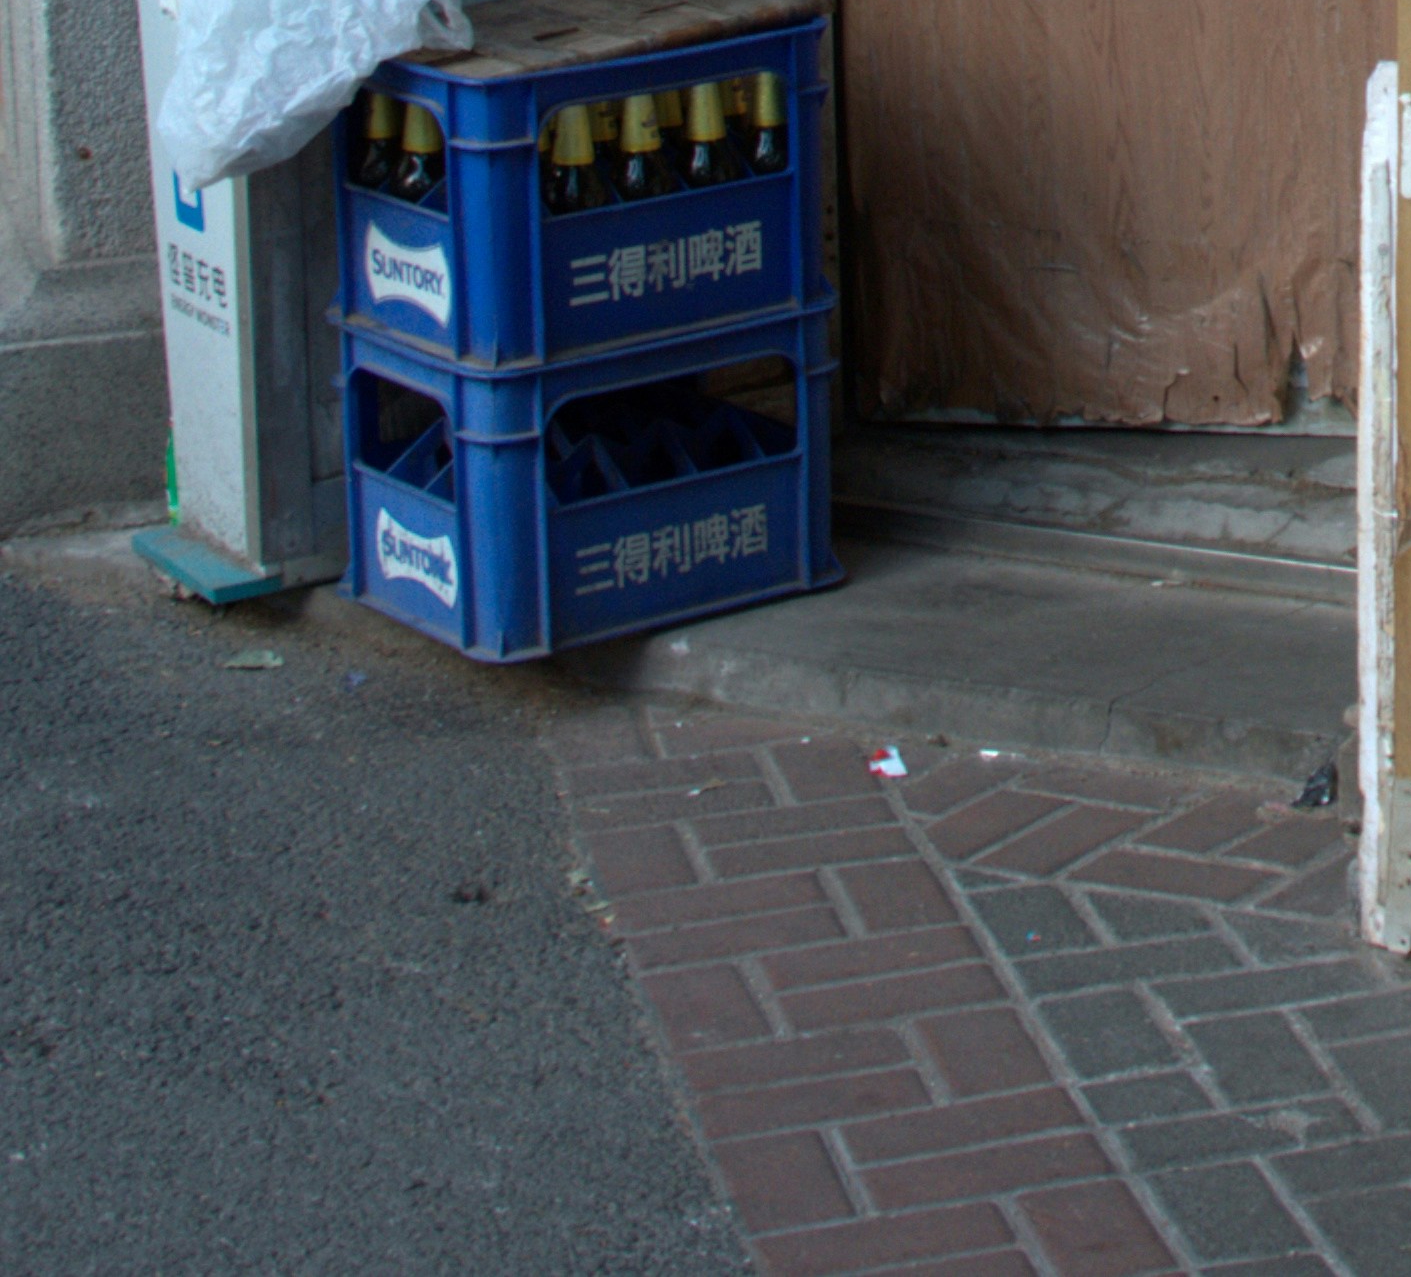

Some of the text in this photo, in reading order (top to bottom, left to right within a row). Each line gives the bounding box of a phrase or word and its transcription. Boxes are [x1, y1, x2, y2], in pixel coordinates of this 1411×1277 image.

[372, 248, 445, 297] SUNTORY
[569, 220, 763, 307] 三得利啤酒
[575, 503, 768, 595] 三得利啤酒
